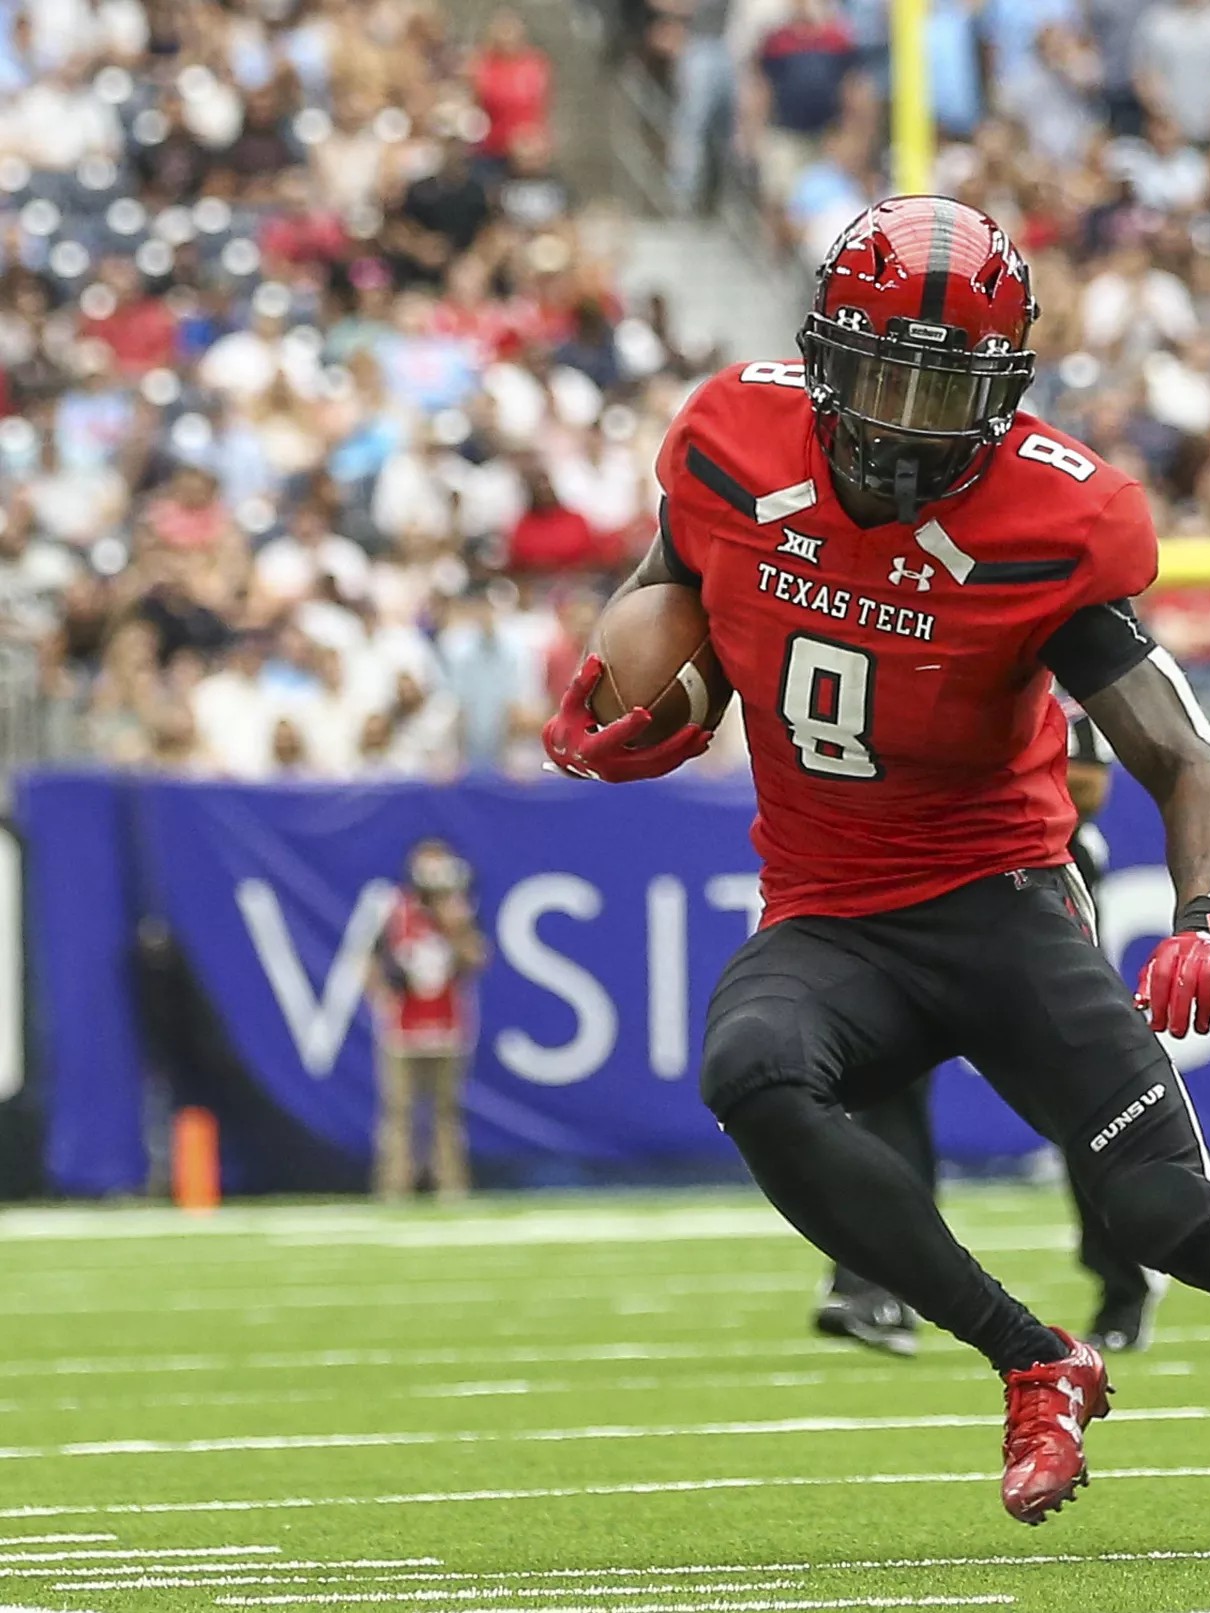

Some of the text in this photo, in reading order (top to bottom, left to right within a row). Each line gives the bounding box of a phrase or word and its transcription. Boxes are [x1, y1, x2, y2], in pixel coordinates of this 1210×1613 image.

[1016, 432, 1098, 483] 8
[758, 562, 935, 640] TEXAS TECH
[782, 634, 879, 779] 8
[234, 868, 764, 1086] VSI
[1089, 1083, 1166, 1153] GUNS UP
